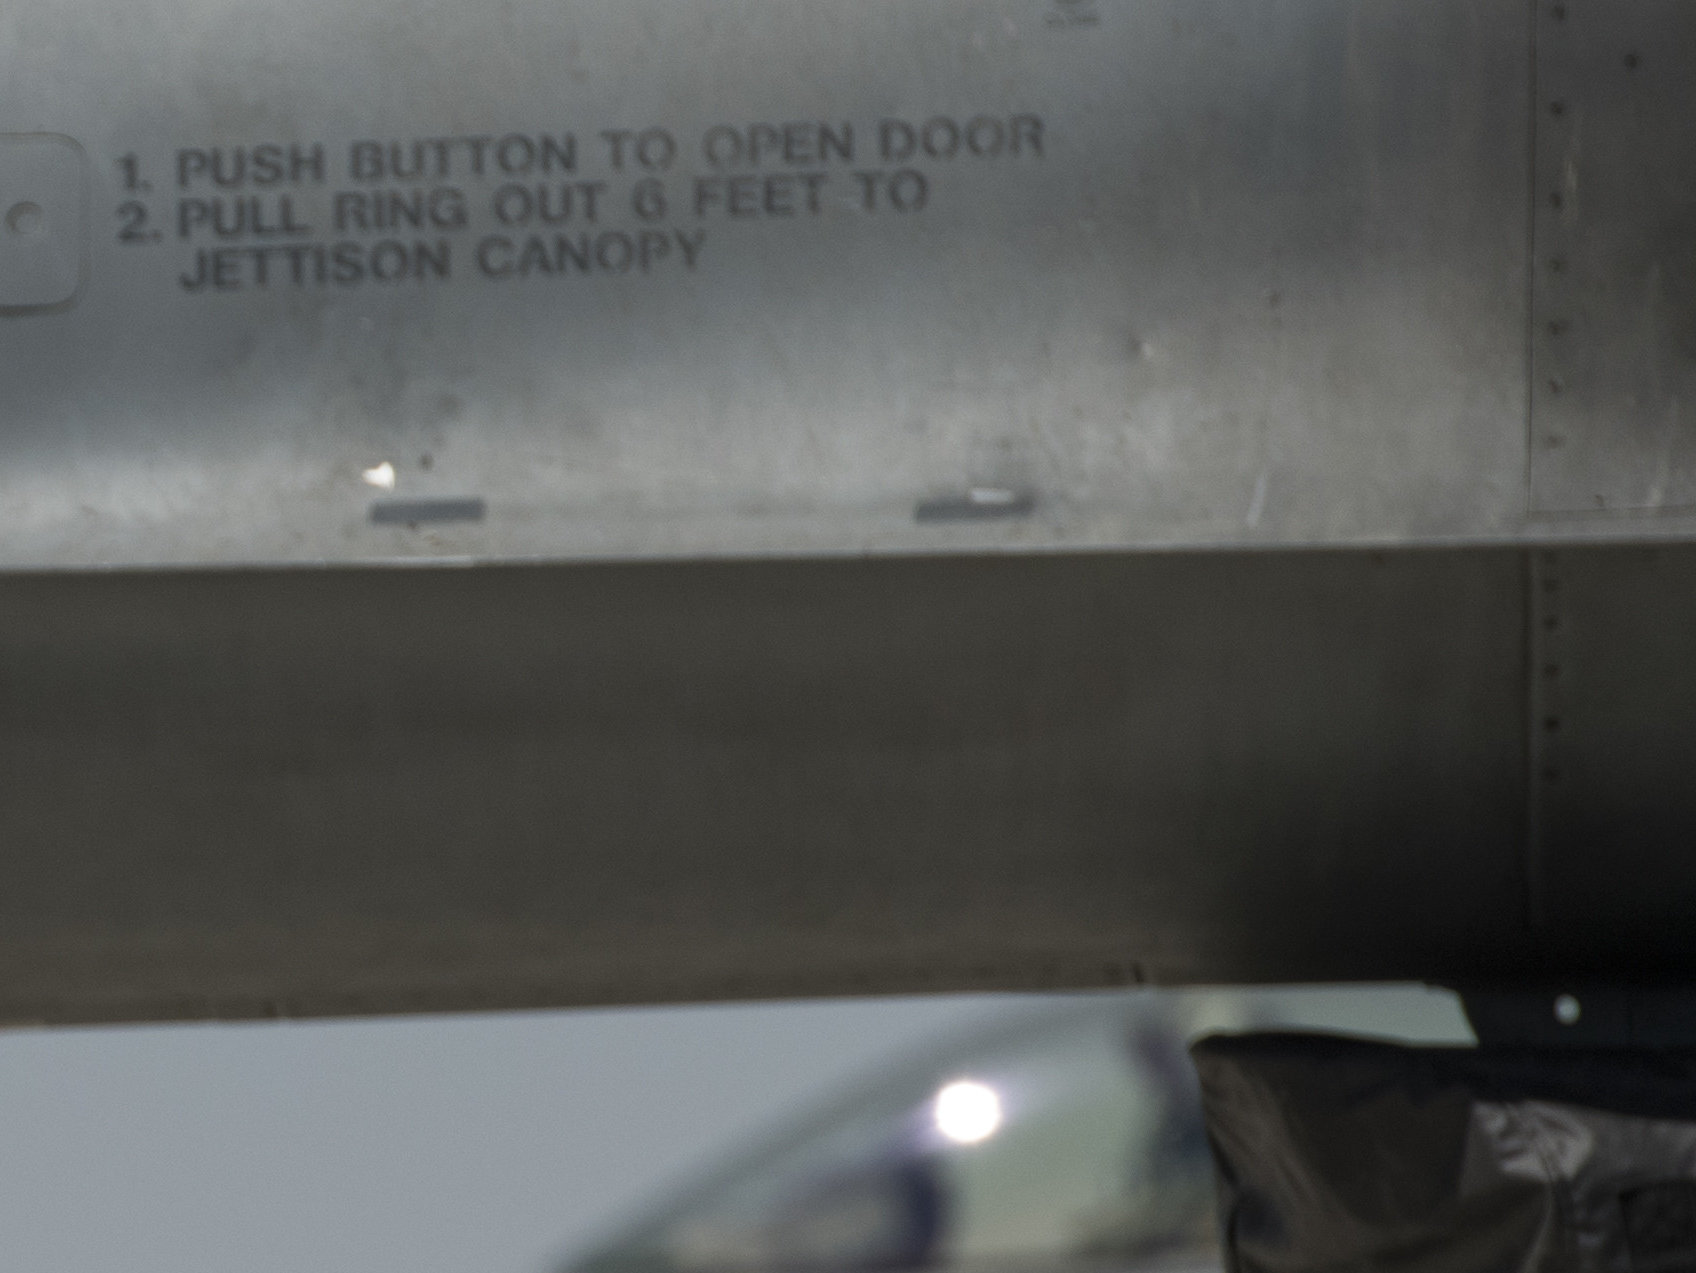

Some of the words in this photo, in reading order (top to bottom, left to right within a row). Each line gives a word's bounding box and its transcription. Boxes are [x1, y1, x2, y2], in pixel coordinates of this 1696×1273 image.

[117, 151, 153, 193] 1.
[177, 143, 325, 191] PUSH
[349, 131, 578, 183] BUTTON
[601, 127, 677, 173] TO
[703, 121, 854, 171] OPEN
[877, 113, 1046, 162] DOOR
[116, 202, 163, 245] 2.
[177, 195, 311, 240] PULL
[334, 186, 468, 233] RING
[493, 181, 605, 227] OUT
[630, 177, 667, 223] 6
[693, 171, 828, 220] FEET
[852, 168, 929, 215] TO
[178, 239, 450, 293] JETTISON
[476, 229, 706, 283] CANOPY
